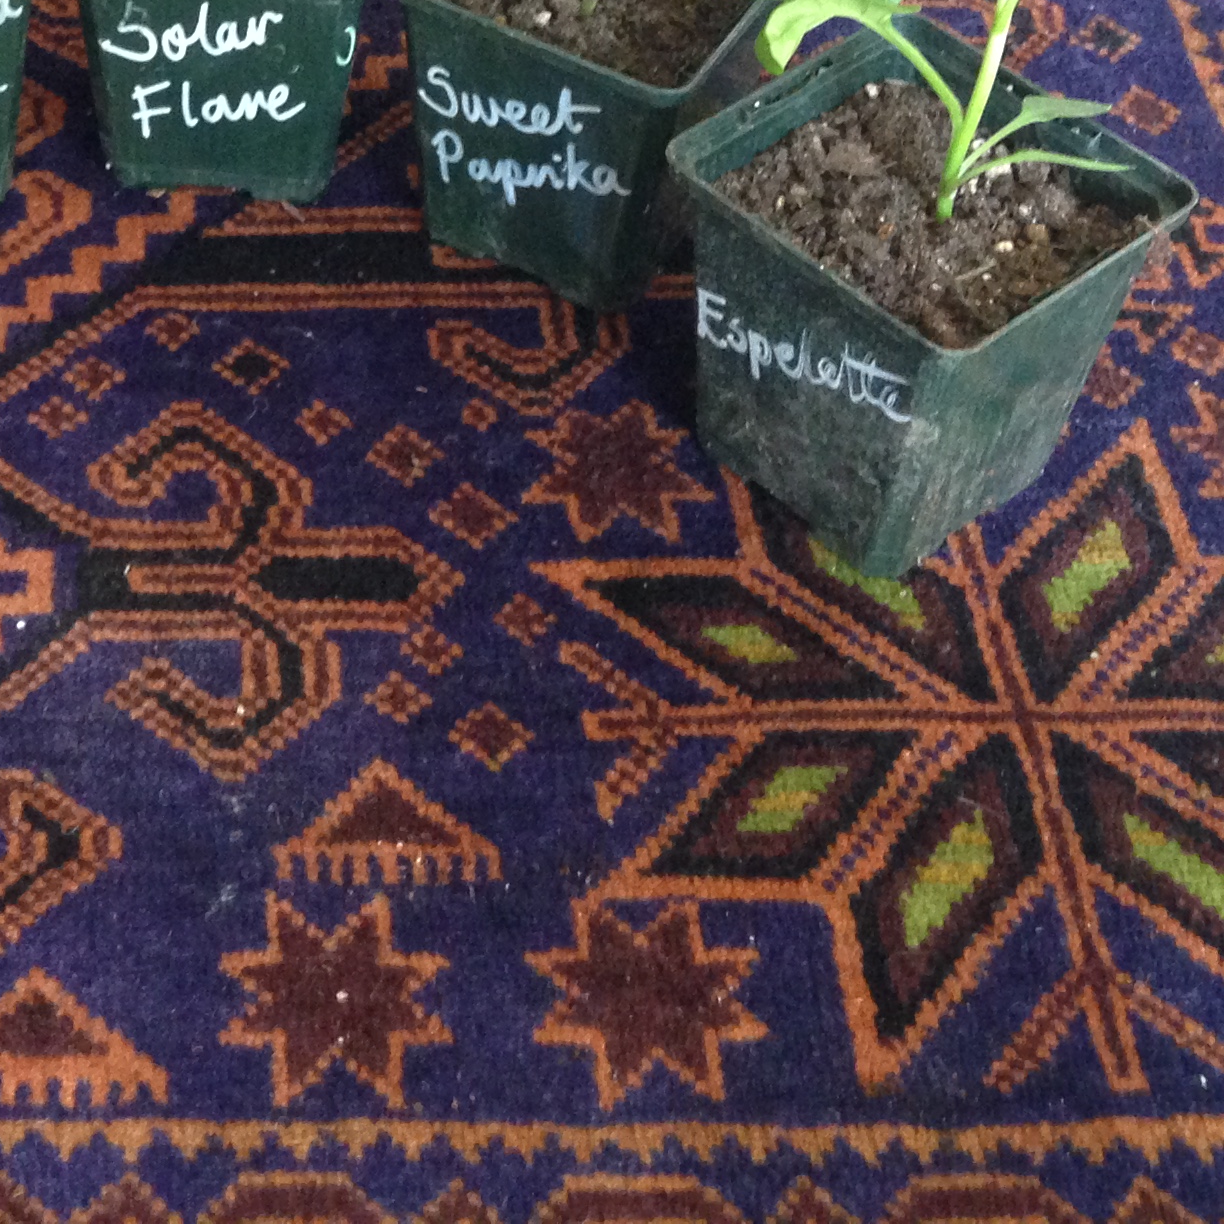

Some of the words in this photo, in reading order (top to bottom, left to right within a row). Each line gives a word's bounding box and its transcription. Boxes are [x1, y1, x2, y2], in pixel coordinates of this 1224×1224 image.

[99, 0, 283, 62] Solar
[131, 80, 306, 139] Flare
[417, 65, 602, 136] Sweet
[431, 128, 632, 206] Paprika
[696, 287, 913, 423] Espelette
